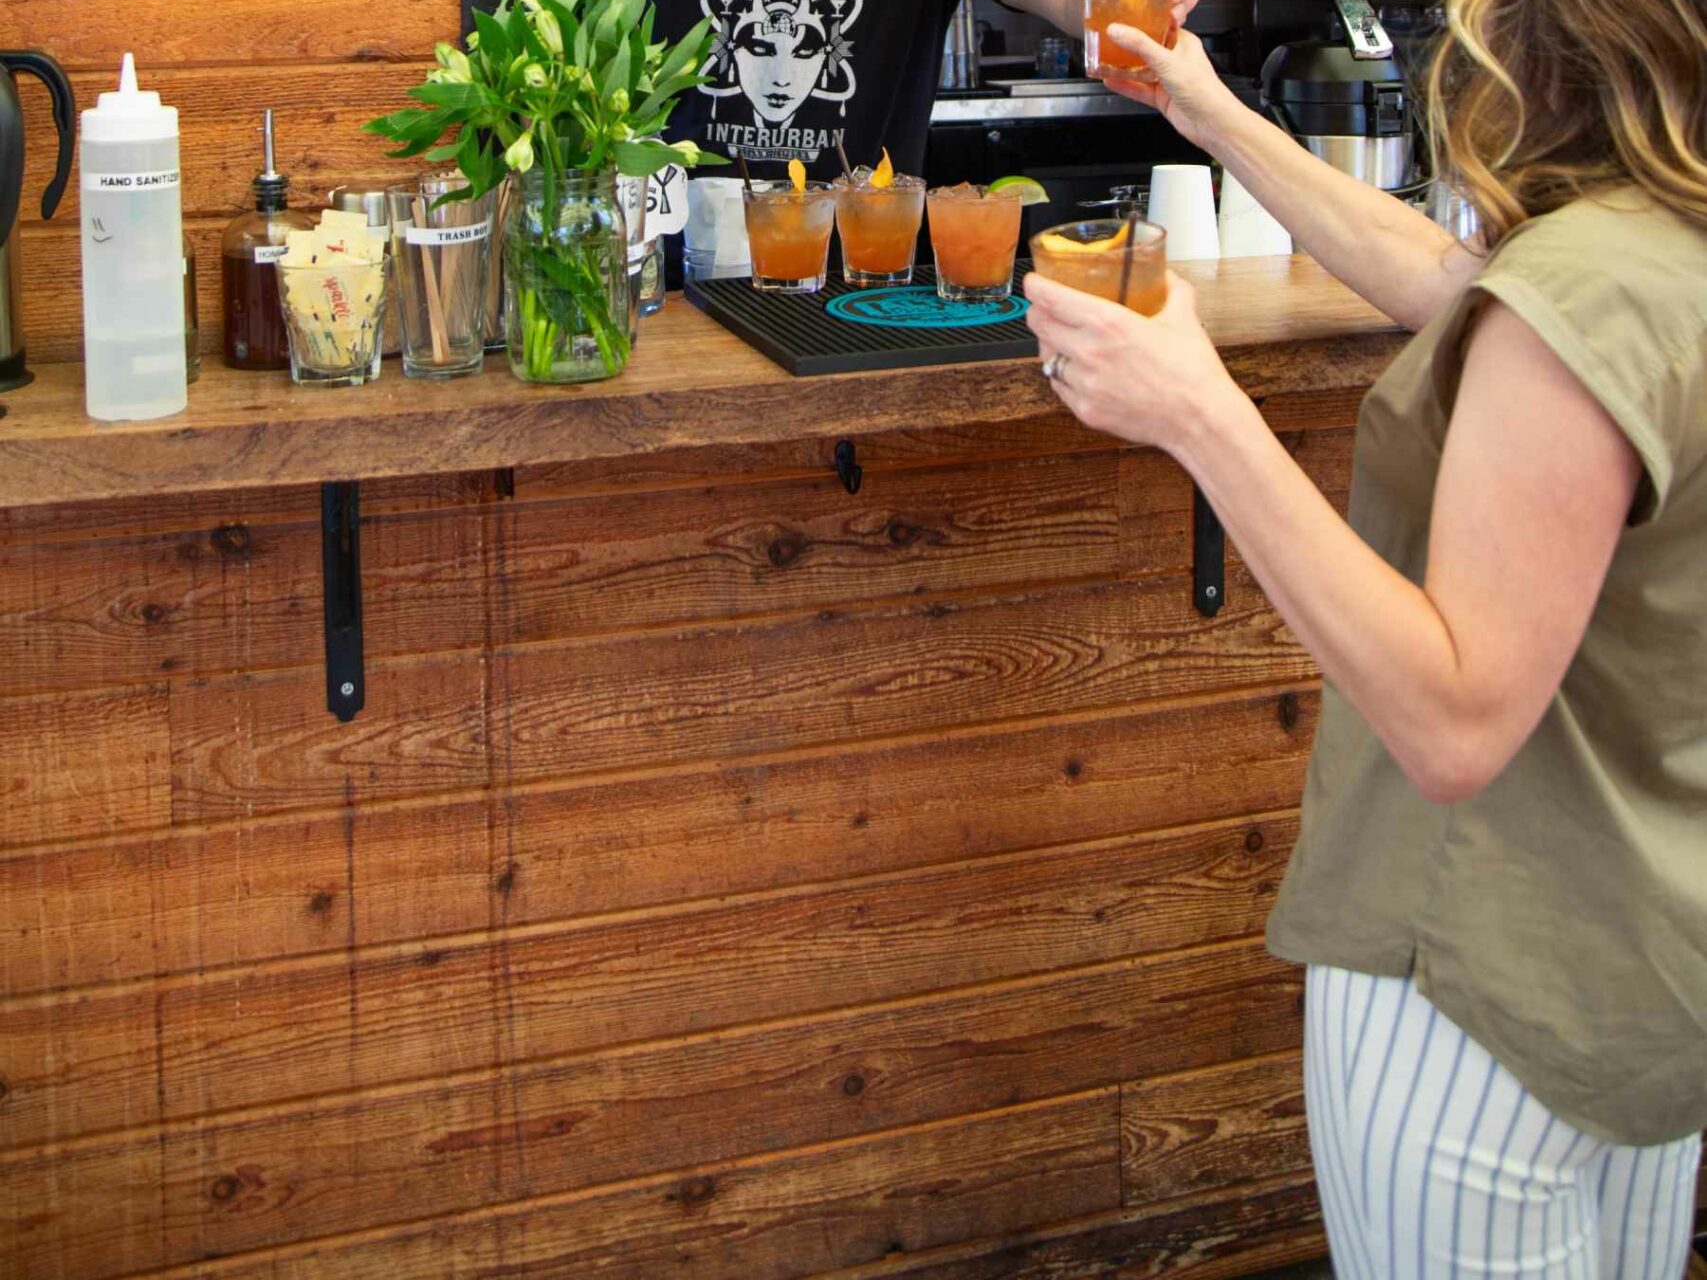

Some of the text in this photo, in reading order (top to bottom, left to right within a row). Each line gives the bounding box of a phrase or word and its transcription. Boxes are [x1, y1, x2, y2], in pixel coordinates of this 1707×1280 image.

[706, 122, 847, 149] INTERURBAN
[100, 176, 132, 187] HAND
[438, 229, 472, 241] TRASH
